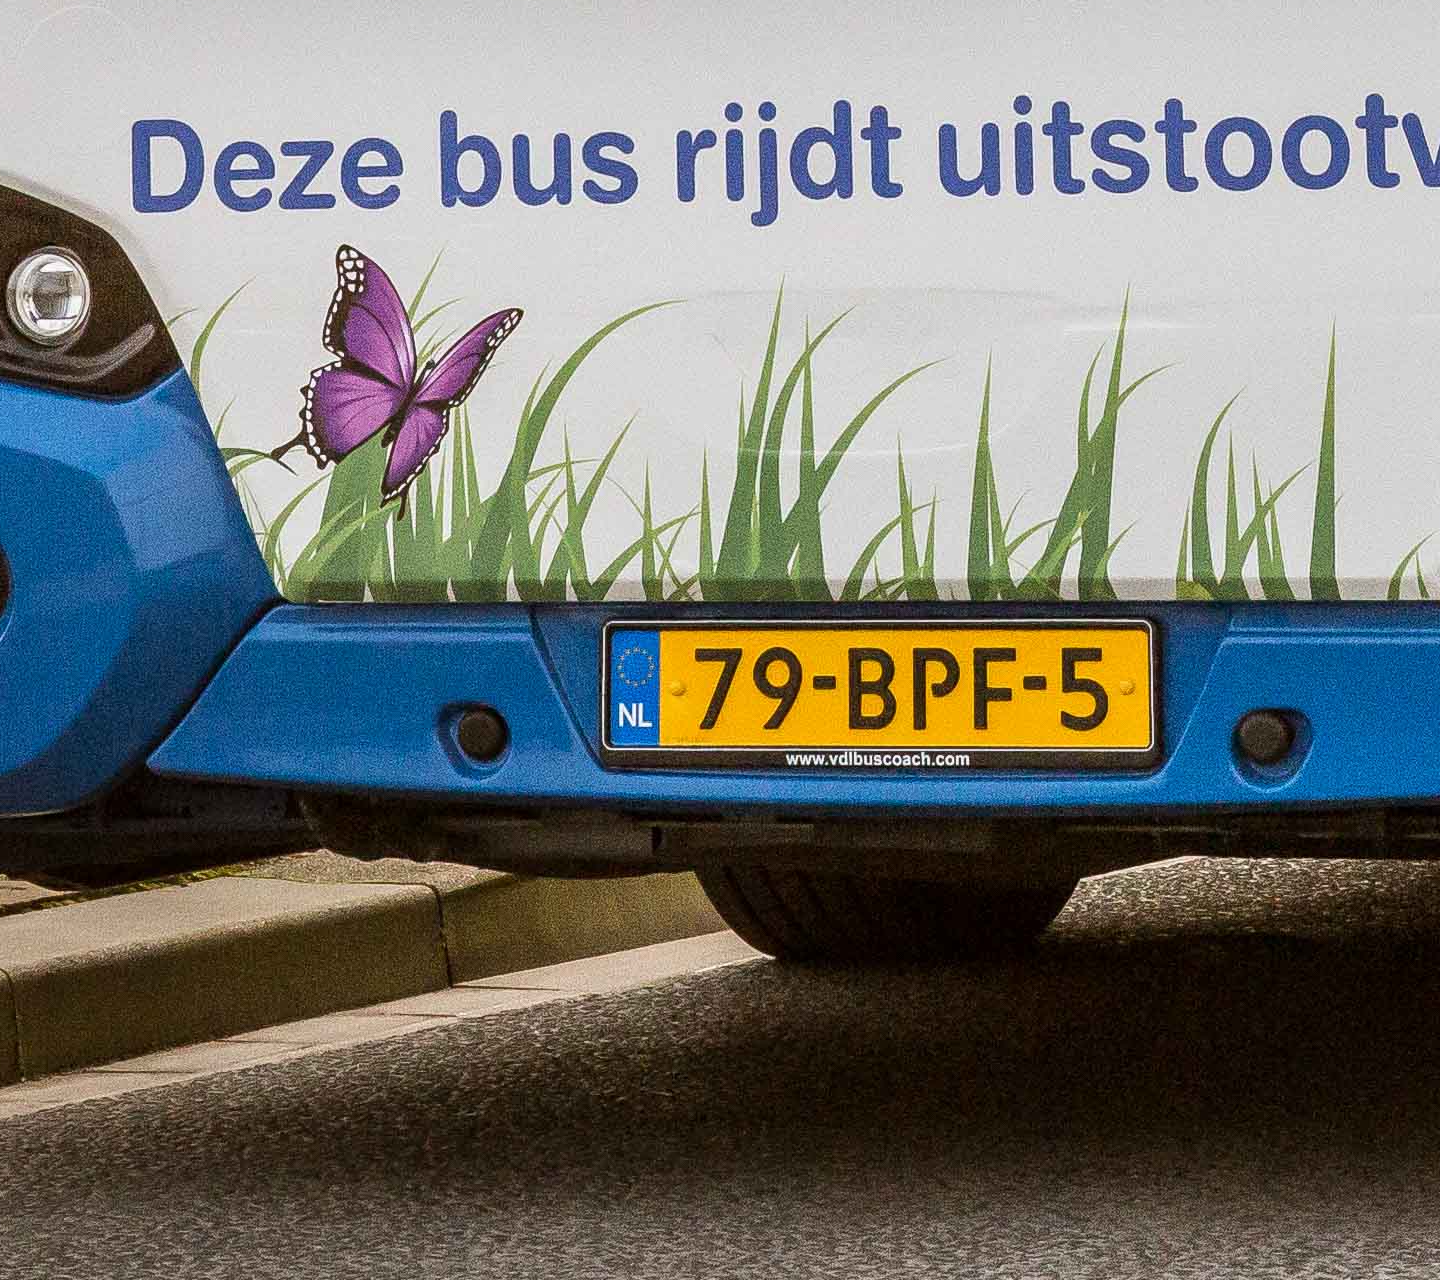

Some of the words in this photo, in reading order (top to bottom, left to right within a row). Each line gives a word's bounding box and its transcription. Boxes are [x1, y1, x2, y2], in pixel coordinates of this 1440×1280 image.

[132, 118, 403, 213] Deze
[440, 110, 638, 208] bus
[676, 99, 903, 226] rijdt
[618, 702, 653, 728] NL
[694, 646, 1109, 731] 79-BPF-5
[786, 750, 971, 767] www.vdlbuscoach.com
